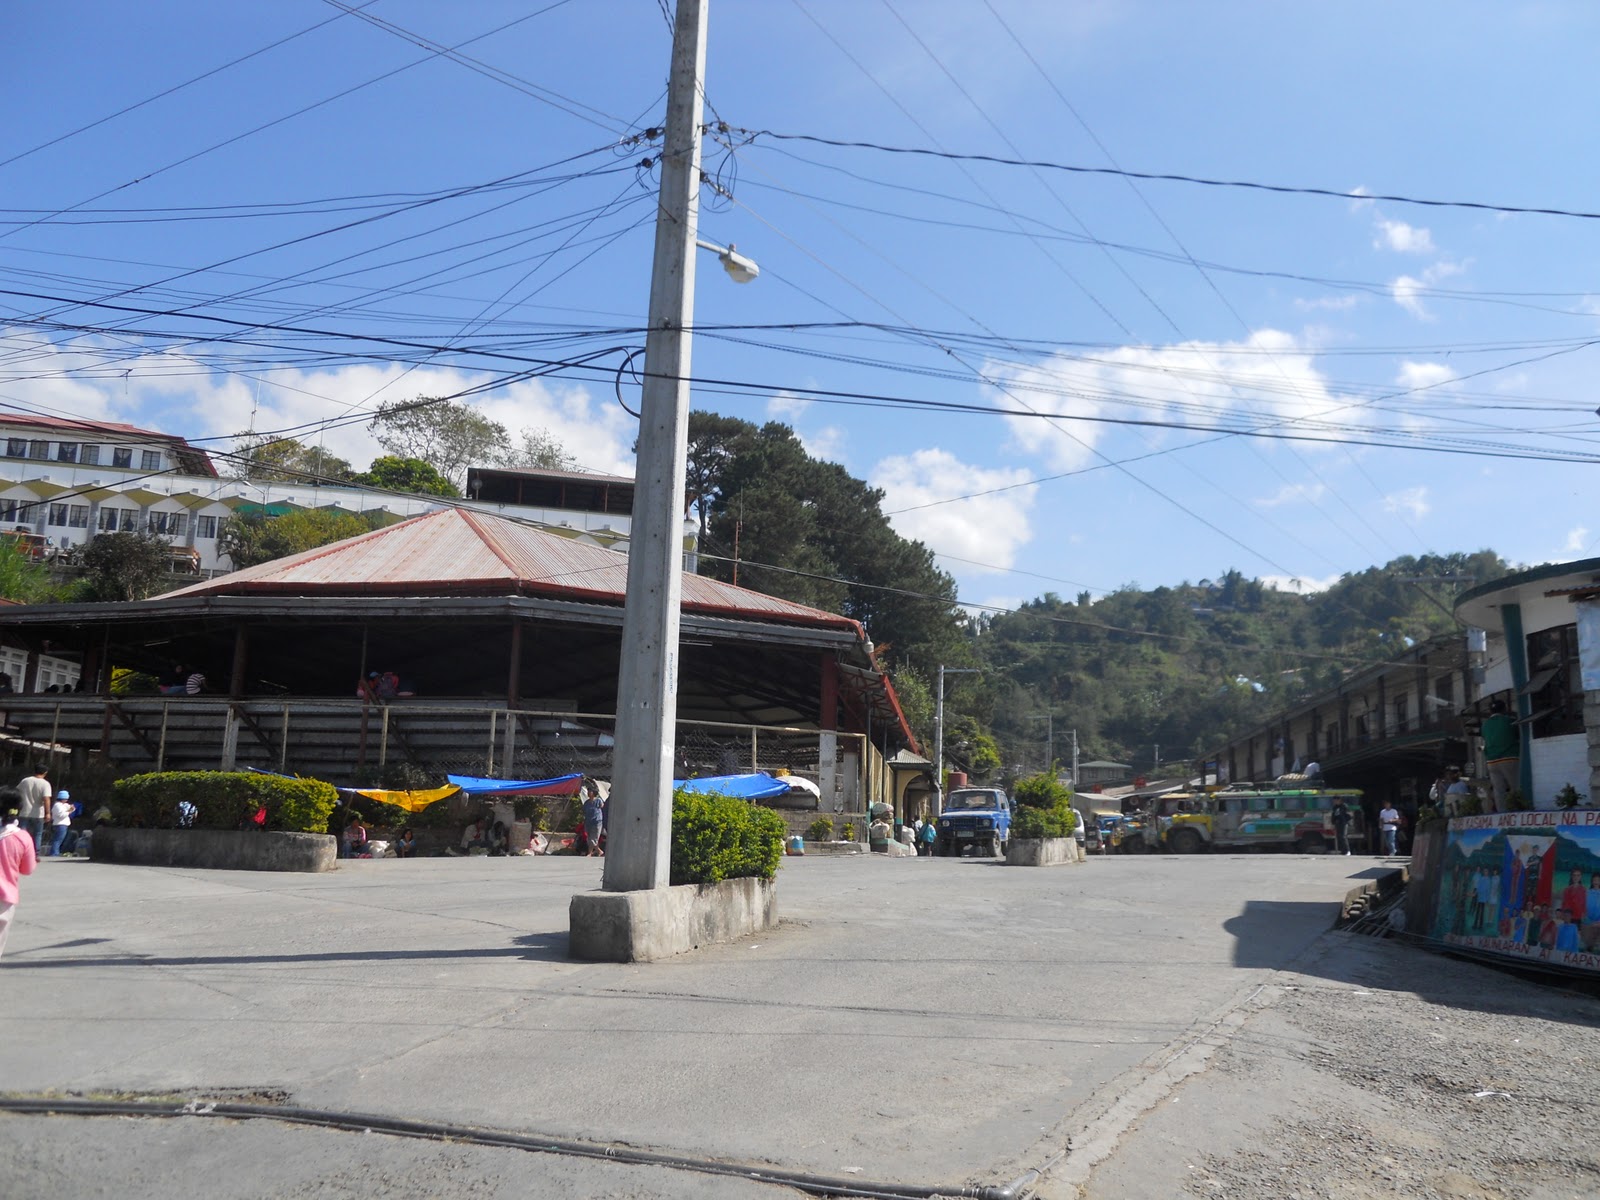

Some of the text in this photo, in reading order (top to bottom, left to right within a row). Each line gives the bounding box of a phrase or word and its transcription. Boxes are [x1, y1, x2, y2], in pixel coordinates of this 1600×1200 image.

[1498, 814, 1517, 826] ANG
[1520, 813, 1556, 827] LOCAL
[1561, 812, 1577, 825] NA
